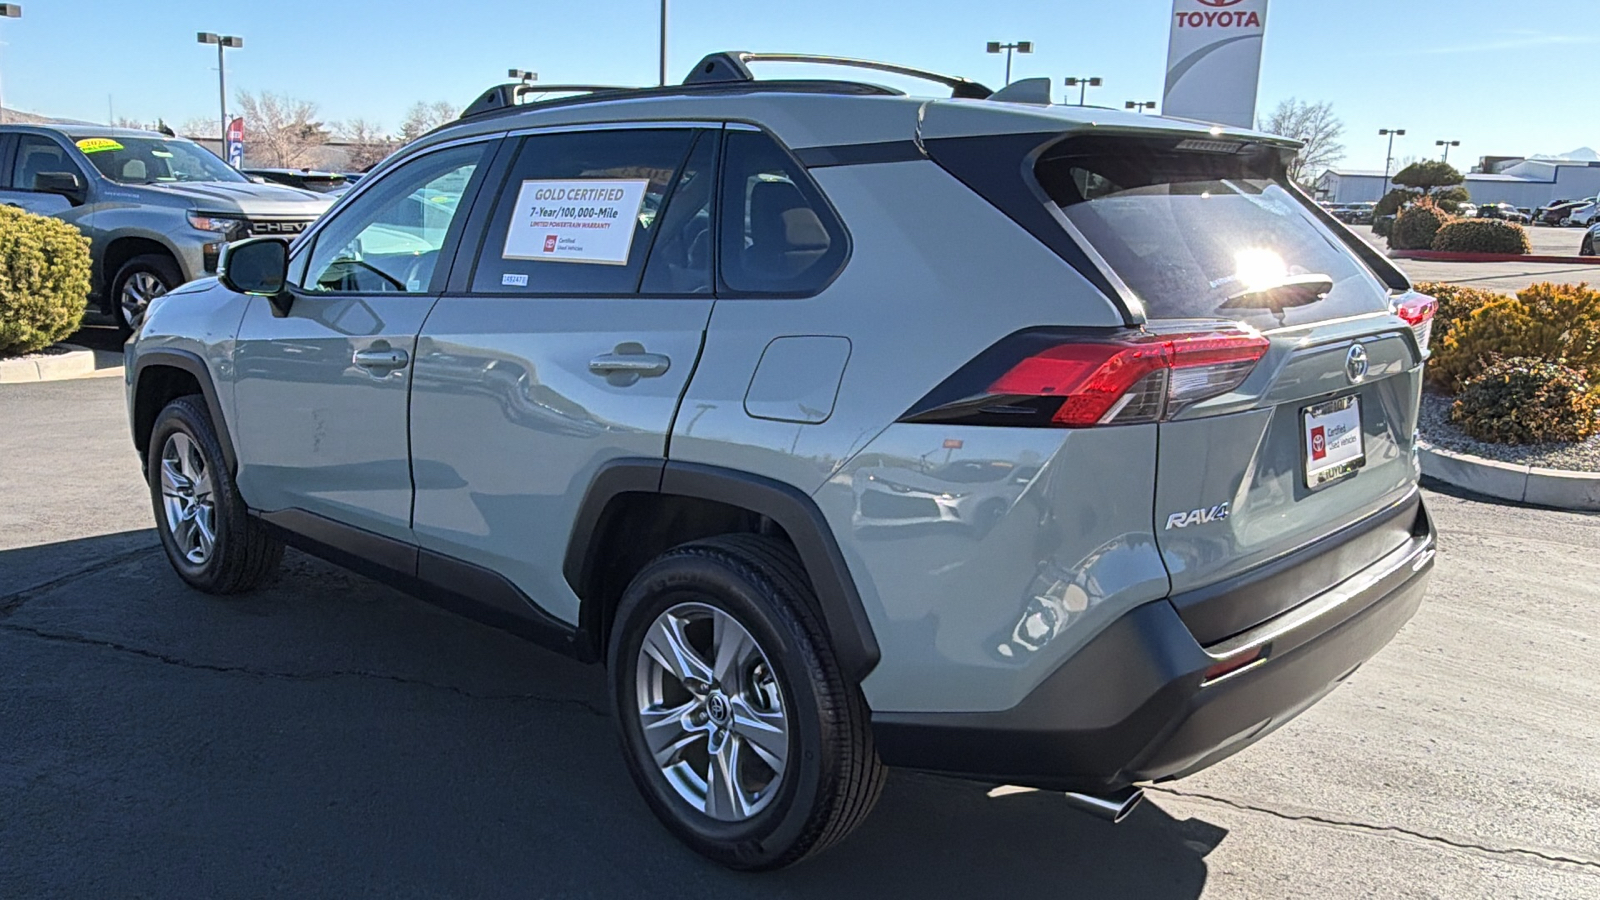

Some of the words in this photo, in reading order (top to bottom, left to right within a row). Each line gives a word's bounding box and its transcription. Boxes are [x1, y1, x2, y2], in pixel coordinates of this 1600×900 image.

[1175, 11, 1260, 28] TOYOTA
[535, 188, 565, 201] GOLD
[567, 188, 624, 201] CERTIFIED
[529, 206, 619, 220] 7-Year/100,000-Mile
[549, 221, 581, 229] POWERTRAIN
[581, 222, 611, 230] WARRANTY
[1327, 424, 1347, 438] Certified
[1327, 441, 1341, 451] Used
[1340, 435, 1357, 447] Vehicles
[1165, 501, 1229, 531] RAV4
